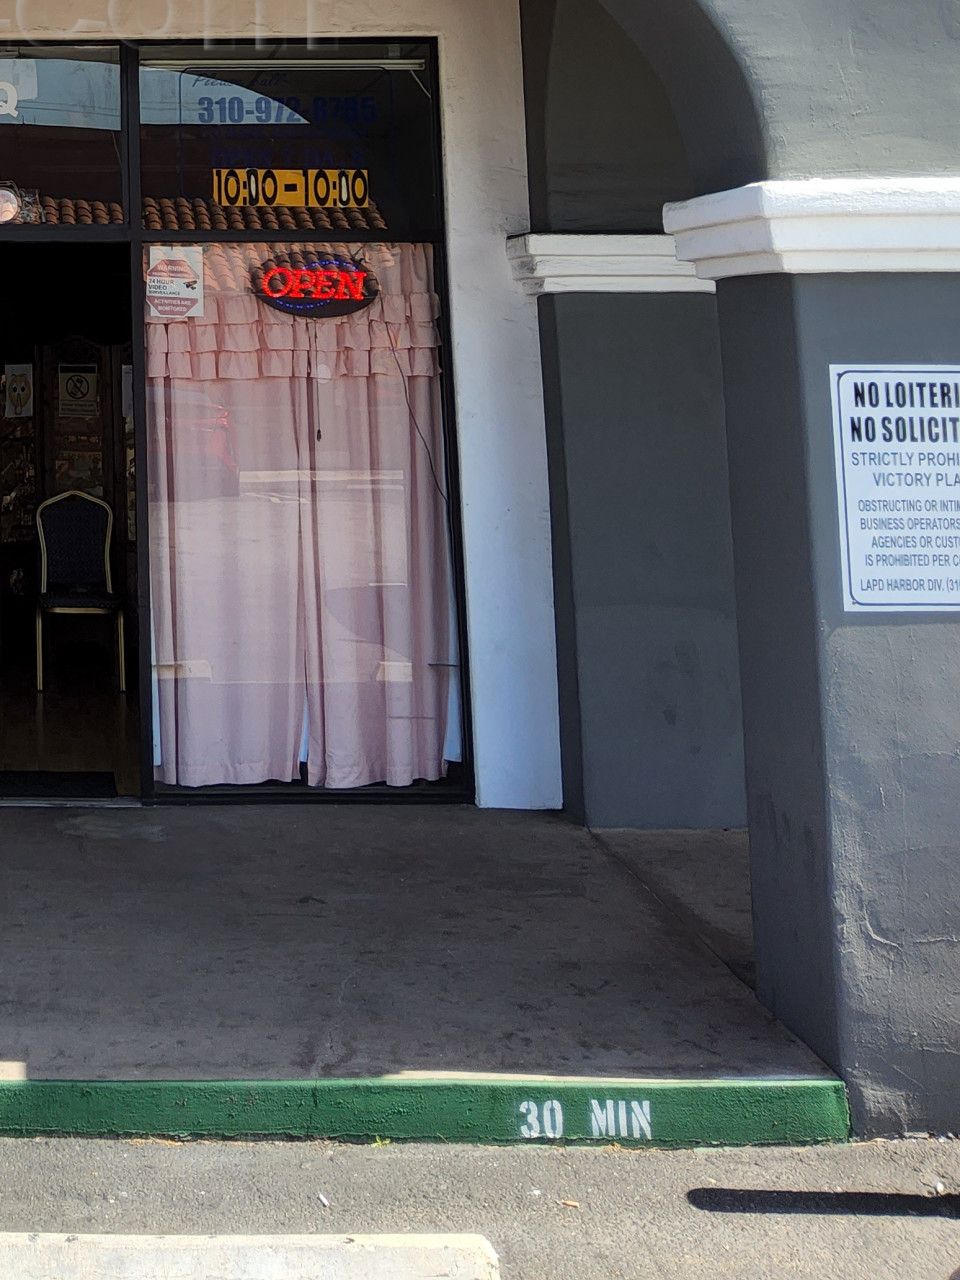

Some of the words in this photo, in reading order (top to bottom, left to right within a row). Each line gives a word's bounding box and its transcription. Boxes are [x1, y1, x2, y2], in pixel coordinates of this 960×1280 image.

[262, 267, 367, 300] OPEN
[853, 381, 880, 408] NO
[850, 416, 876, 443] NO
[851, 452, 915, 466] STRICTLY
[873, 472, 932, 487] VICTORY
[858, 500, 922, 512] OBSTRUCTING
[924, 500, 938, 512] OR
[860, 518, 905, 530] BUSINESS
[872, 536, 917, 548] AGENCIES
[919, 536, 933, 548] OR
[865, 554, 874, 567] IS
[876, 554, 930, 567] PROHIBITED
[933, 554, 951, 567] PER
[860, 579, 884, 592] LAPD
[887, 579, 926, 592] HARBOR
[519, 1100, 563, 1138] 30
[591, 1100, 652, 1140] MIN
